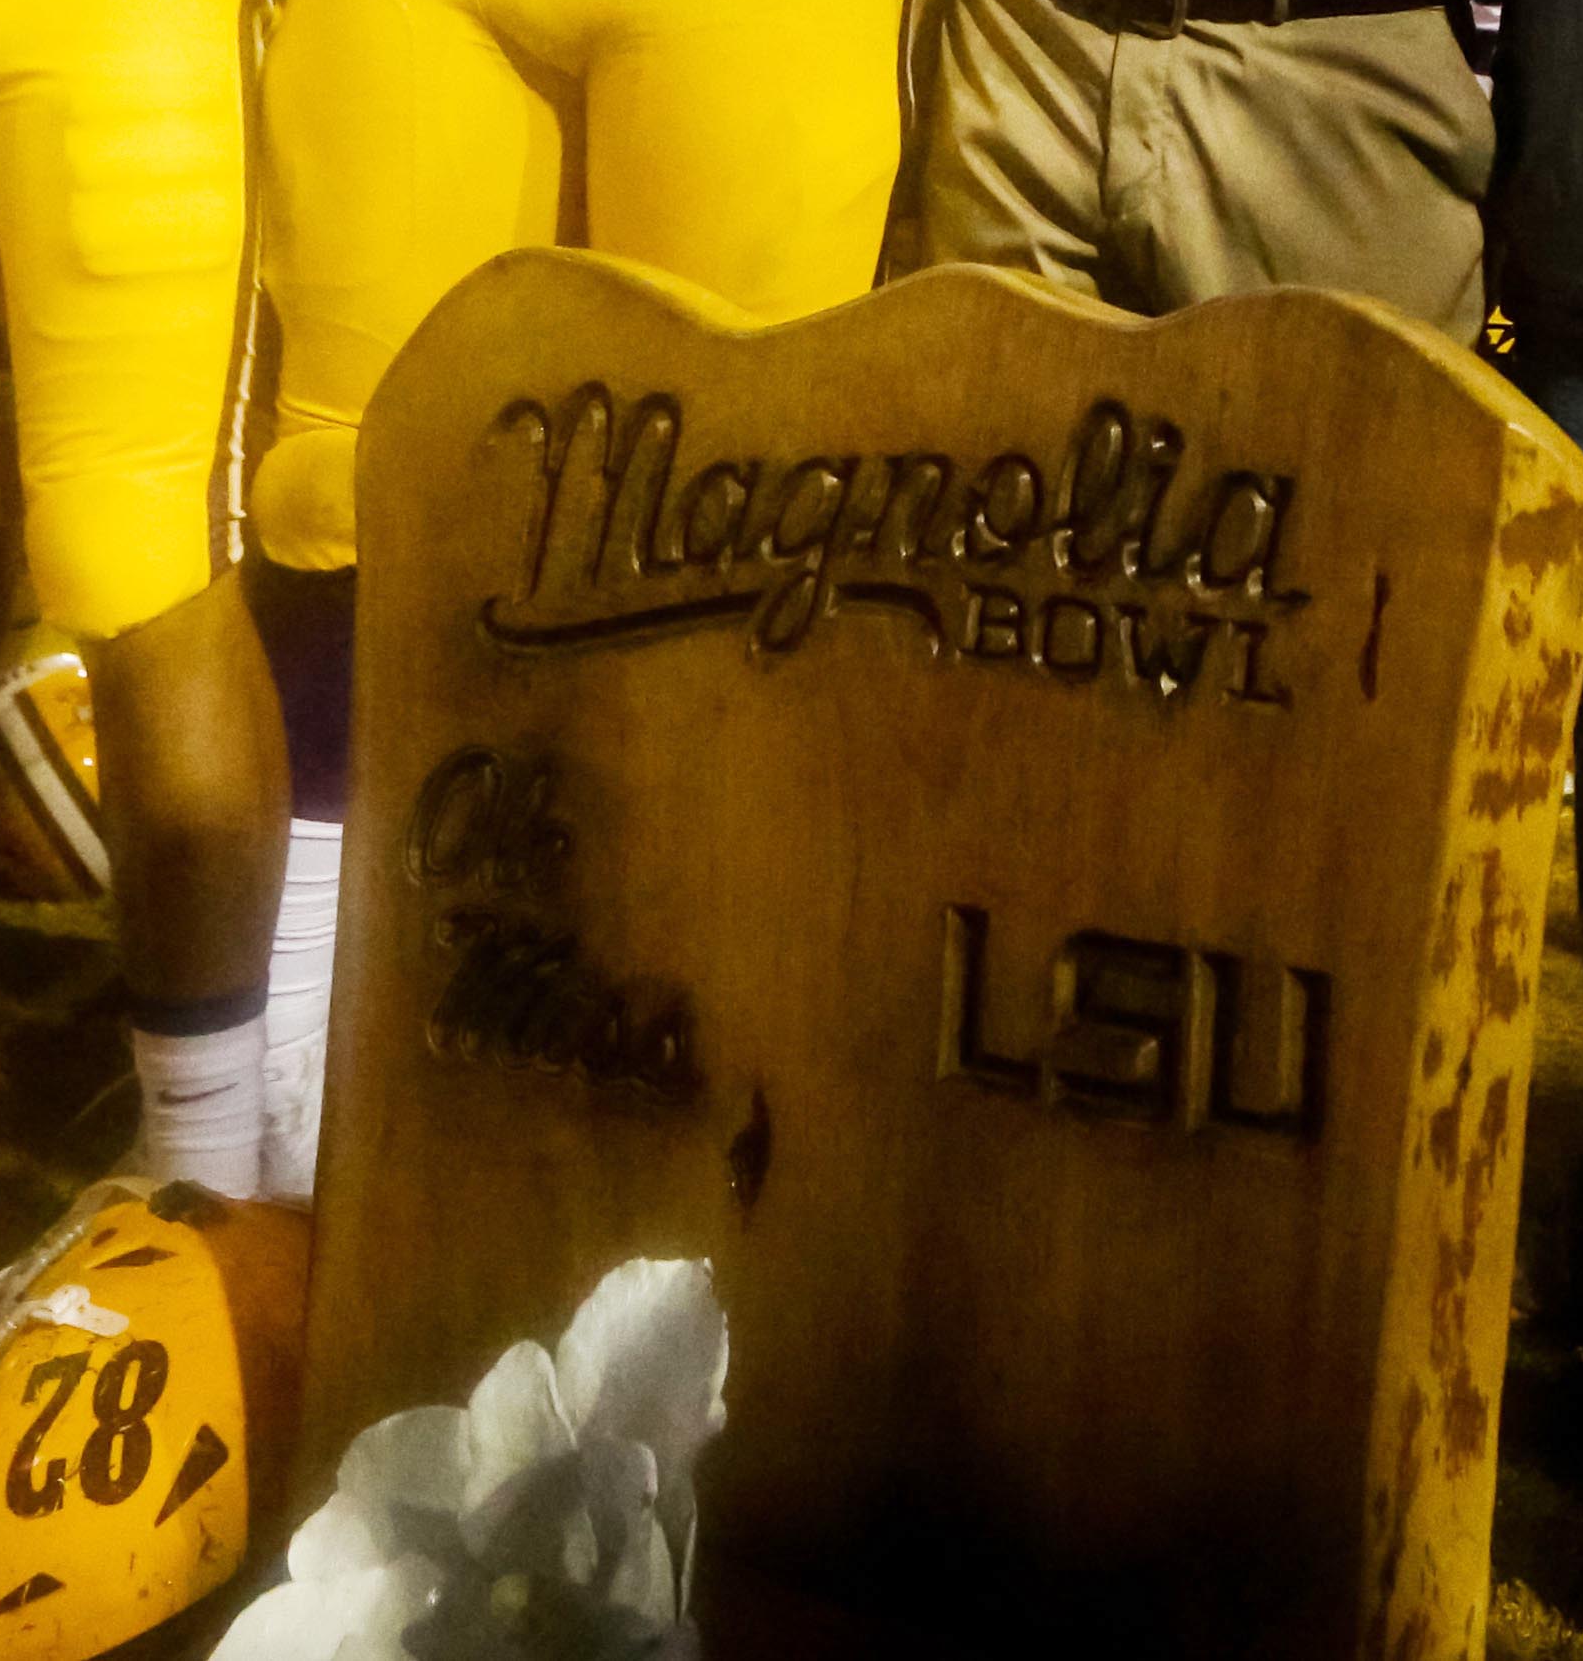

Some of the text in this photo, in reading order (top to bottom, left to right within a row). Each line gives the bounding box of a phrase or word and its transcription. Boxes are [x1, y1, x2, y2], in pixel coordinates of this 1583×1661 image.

[482, 380, 1310, 660] Magnolia
[957, 581, 1294, 712] BOWL
[936, 902, 1334, 1141] LSU
